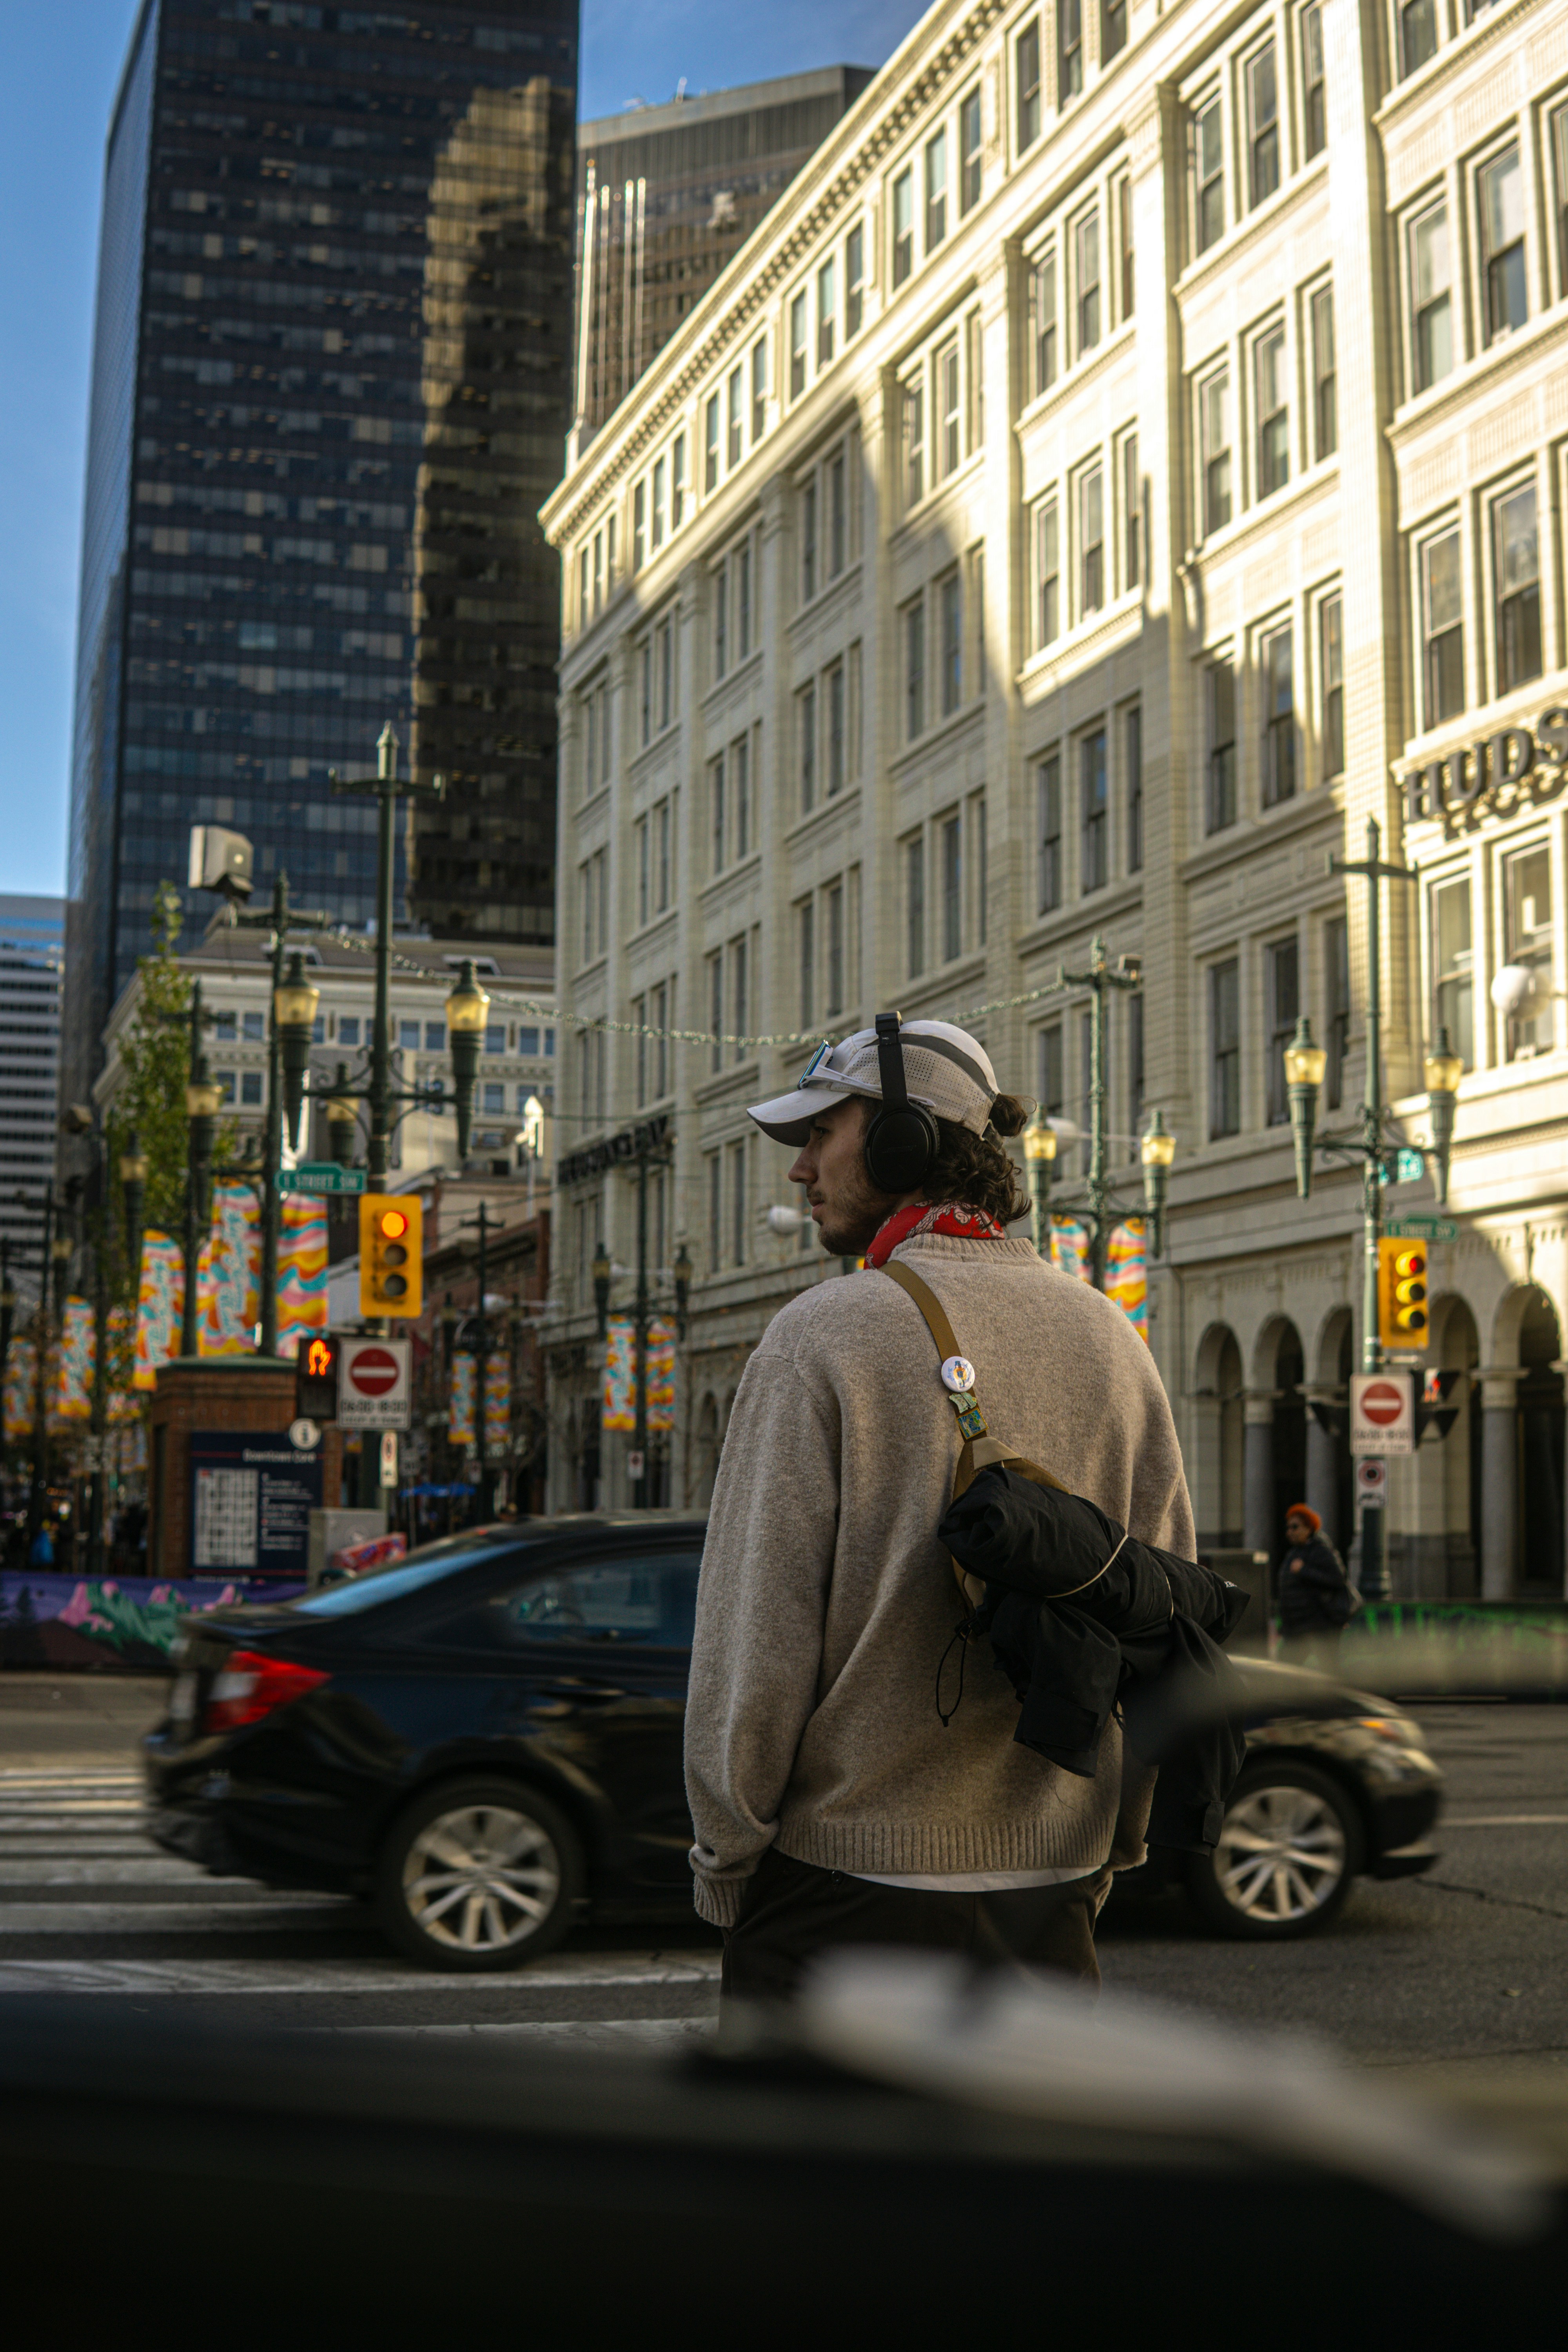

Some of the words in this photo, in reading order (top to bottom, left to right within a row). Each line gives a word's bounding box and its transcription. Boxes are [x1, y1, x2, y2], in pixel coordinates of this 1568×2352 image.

[295, 1174, 334, 1189] STREET
[340, 1175, 358, 1189] SW
[242, 1448, 292, 1463] Downtown
[292, 1450, 317, 1464] Core
